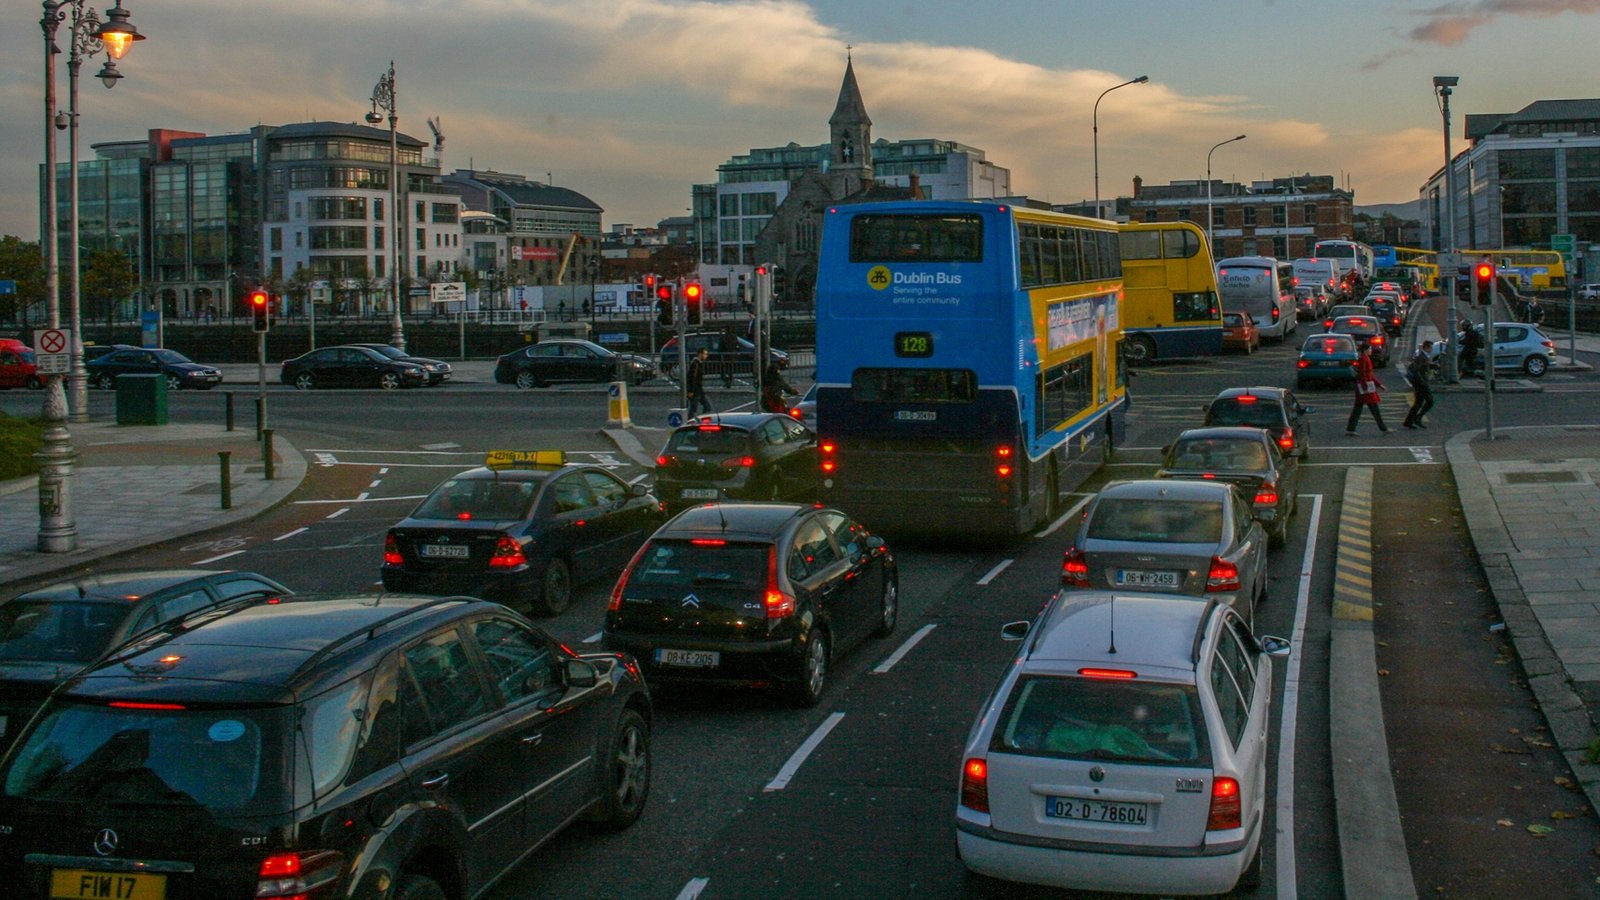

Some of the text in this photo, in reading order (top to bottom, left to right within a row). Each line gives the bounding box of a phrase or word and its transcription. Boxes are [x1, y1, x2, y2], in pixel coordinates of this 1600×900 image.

[893, 272, 962, 284] Dublin Bus
[893, 286, 938, 295] Serving the
[893, 296, 961, 305] entire community
[903, 337, 928, 352] 128
[1126, 572, 1174, 584] 06-WH-2458
[666, 651, 714, 665] 08-KE-2105
